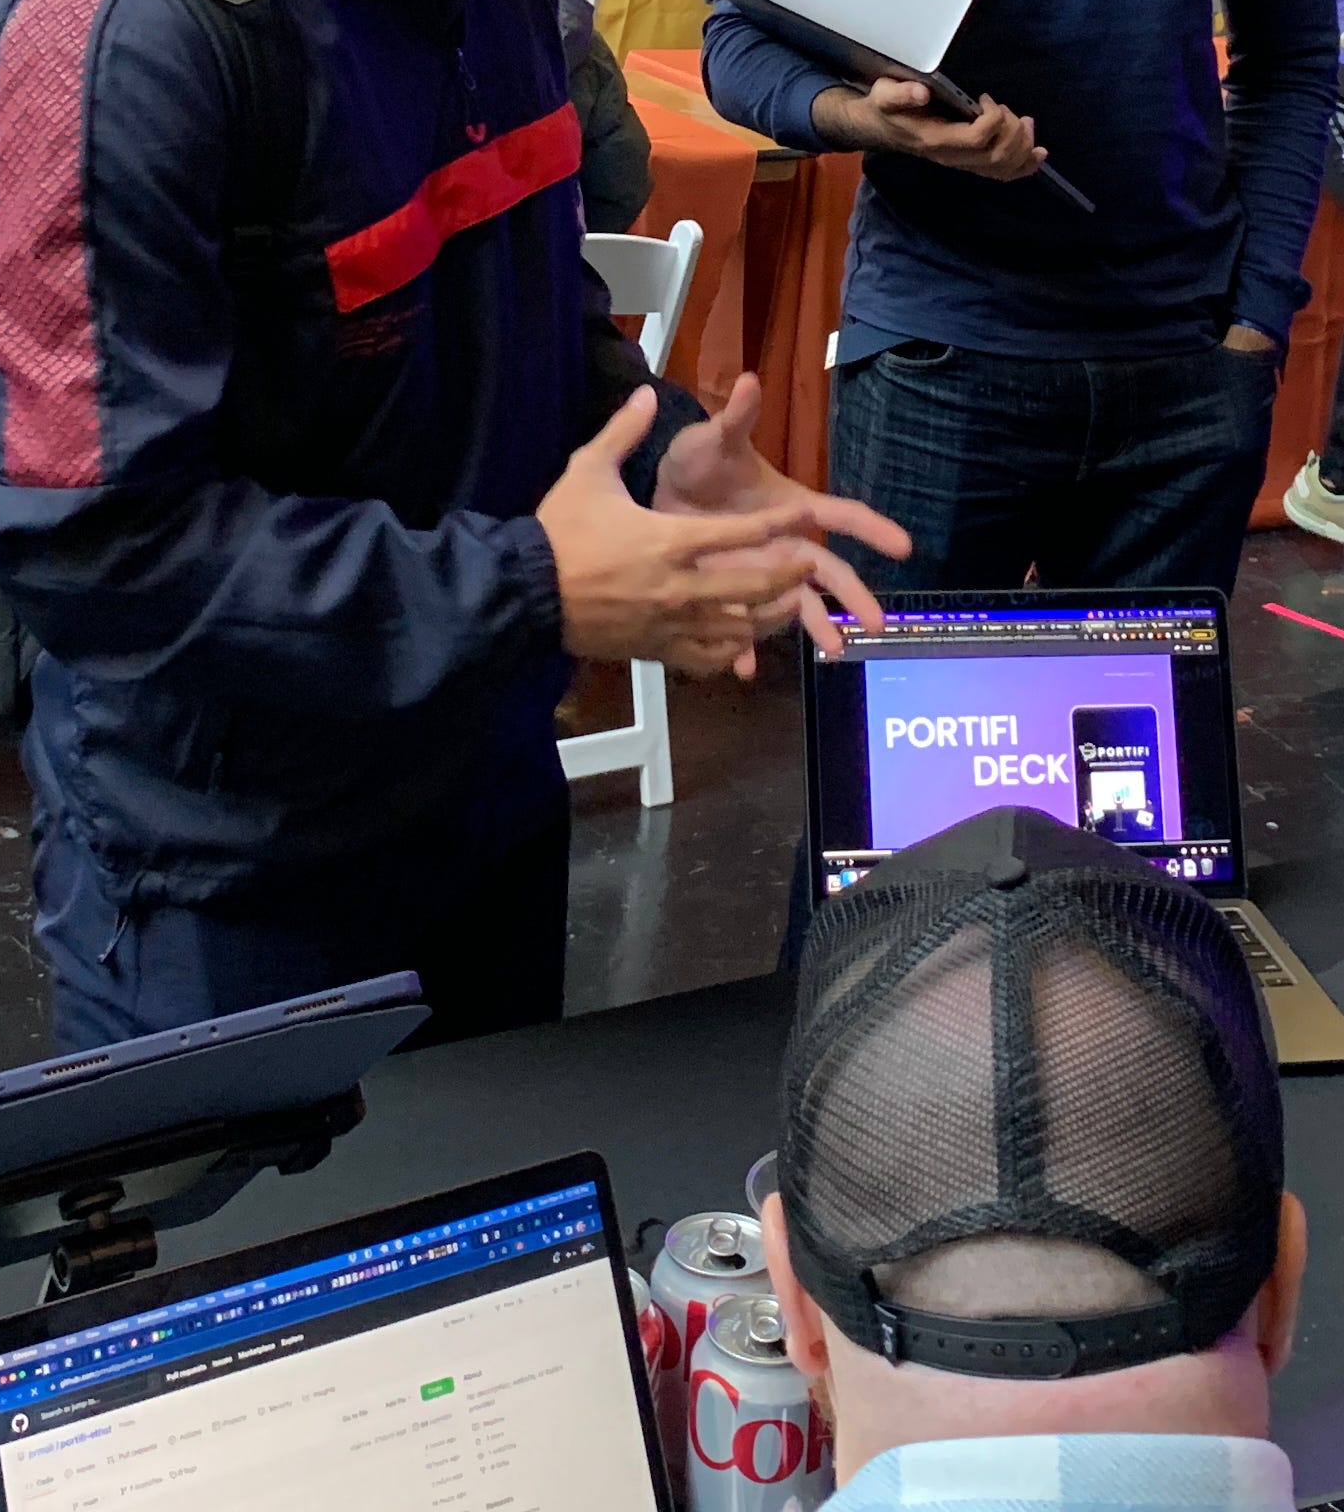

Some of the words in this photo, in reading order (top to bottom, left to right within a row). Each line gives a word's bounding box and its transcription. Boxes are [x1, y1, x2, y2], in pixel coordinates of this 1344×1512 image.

[885, 715, 1019, 749] PORTIFI
[1098, 746, 1150, 757] PORTIFI
[974, 753, 1070, 787] DECK
